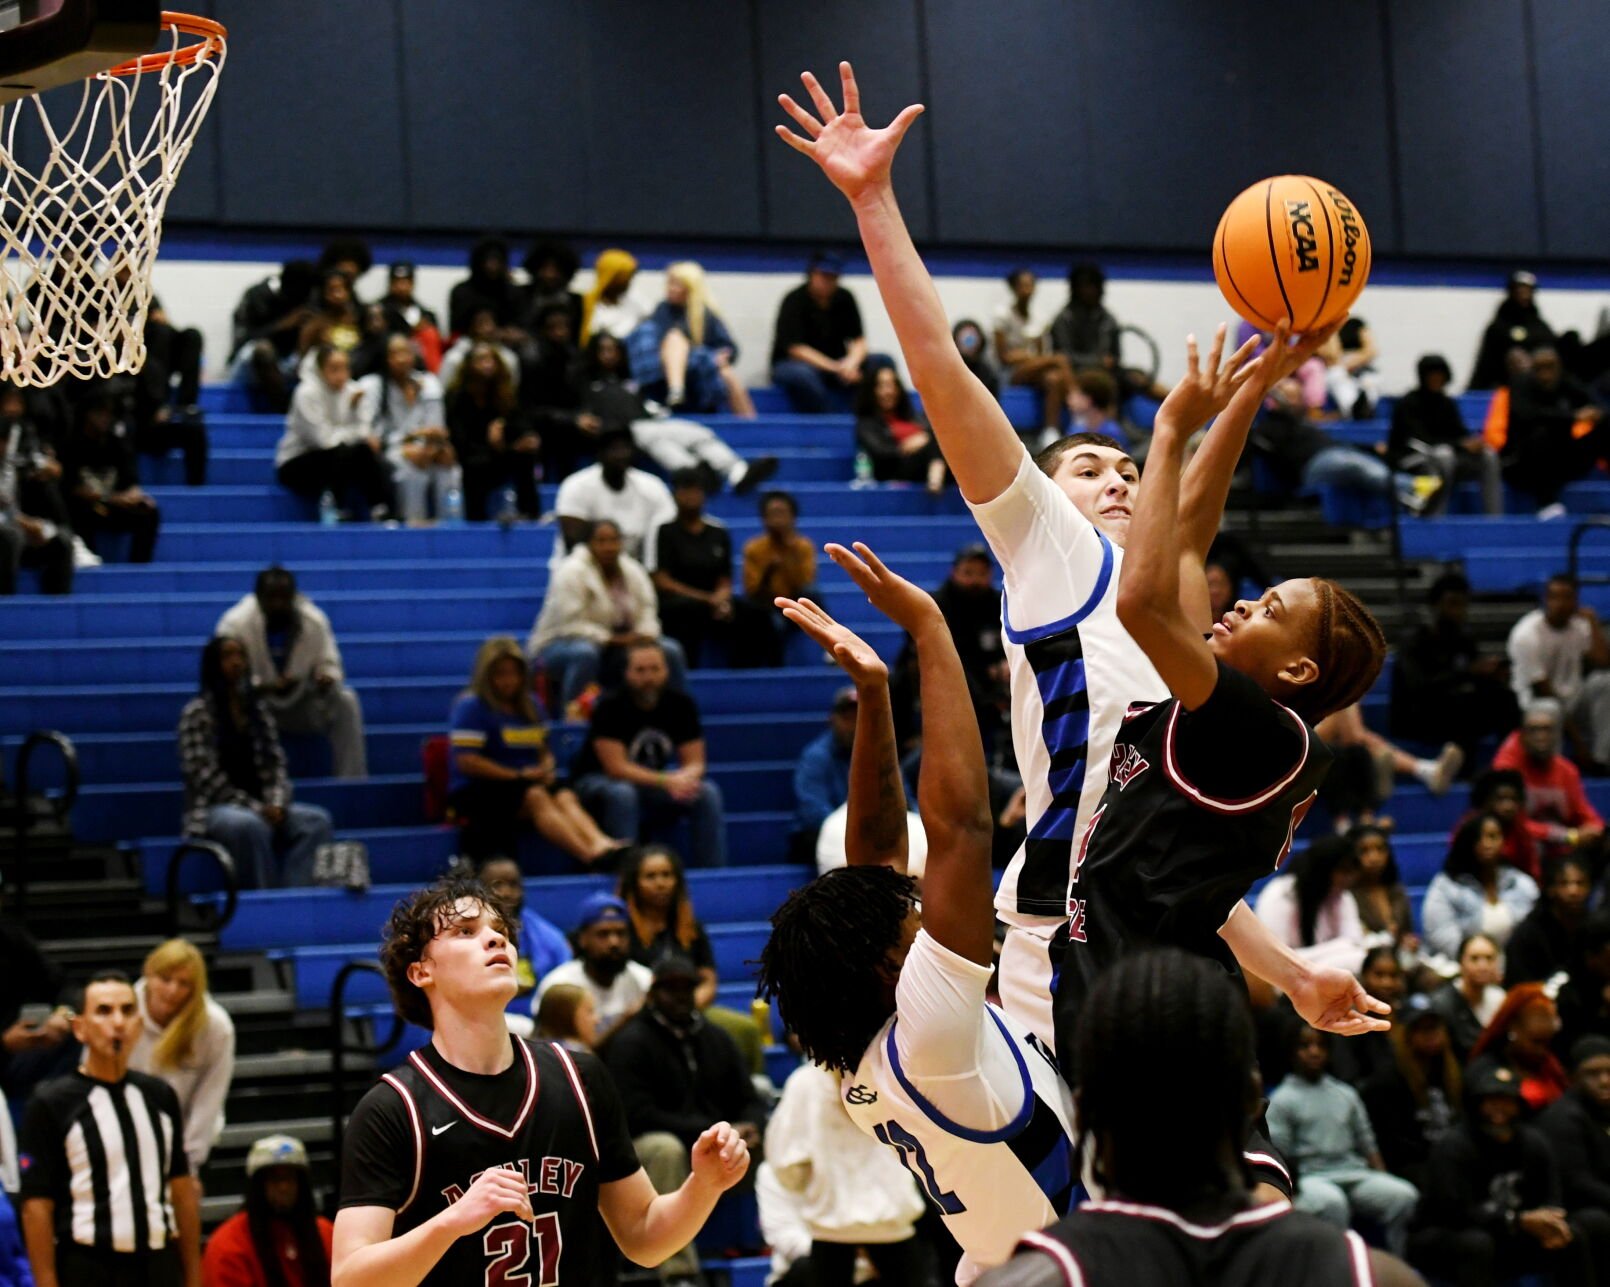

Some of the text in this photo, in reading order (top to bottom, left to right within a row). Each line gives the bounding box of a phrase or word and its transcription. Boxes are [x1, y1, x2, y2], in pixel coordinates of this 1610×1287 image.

[1287, 201, 1320, 273] NCAA
[1327, 188, 1361, 288] Wilson
[440, 1155, 585, 1206] ALEY
[872, 1119, 967, 1215] 12
[483, 1211, 563, 1287] 21
